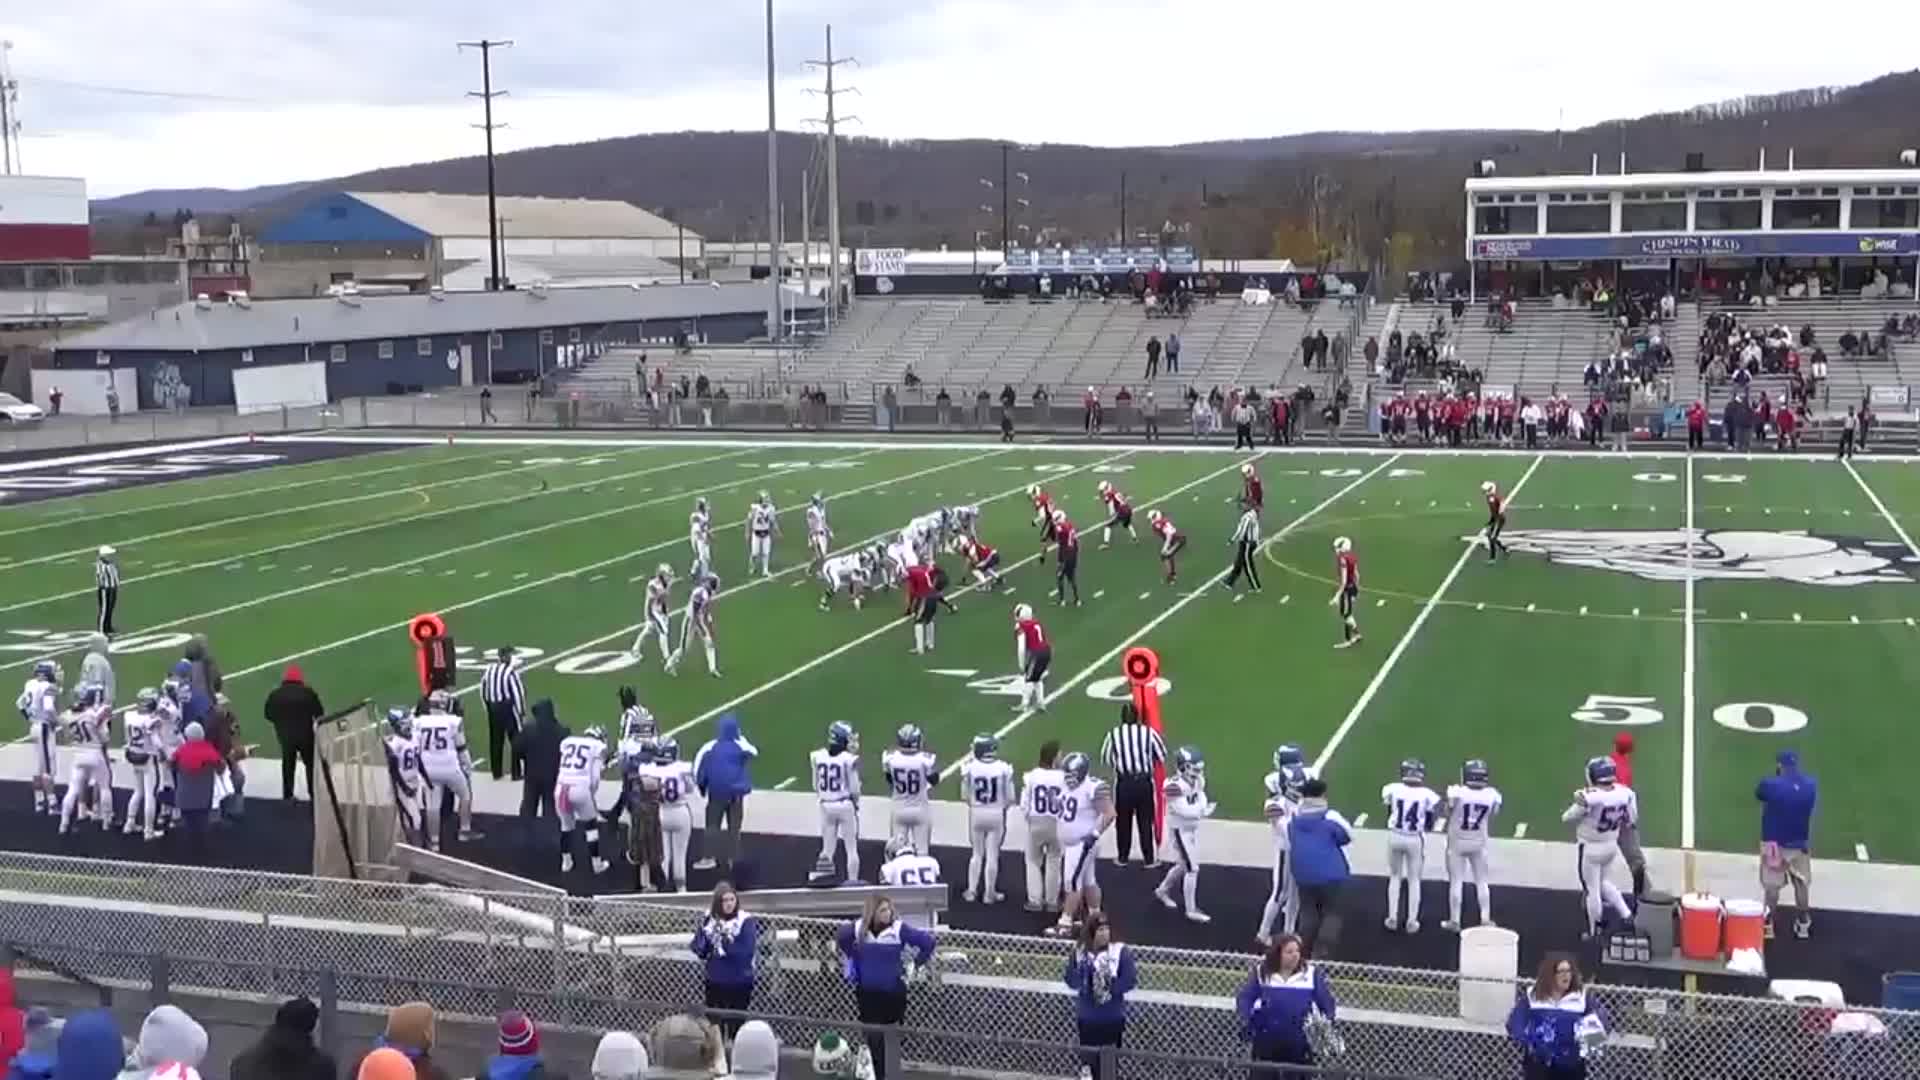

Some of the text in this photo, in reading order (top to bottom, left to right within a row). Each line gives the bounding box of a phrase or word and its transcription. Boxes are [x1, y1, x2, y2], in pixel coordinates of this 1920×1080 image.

[1874, 239, 1897, 250] WISE
[431, 640, 446, 669] 1
[1570, 694, 1807, 733] 50
[421, 727, 448, 750] 75
[561, 743, 590, 770] 25
[817, 762, 841, 793] 32
[894, 767, 921, 795] 56
[973, 776, 999, 804] 21
[1395, 799, 1419, 832] 14
[1461, 803, 1489, 831] 17
